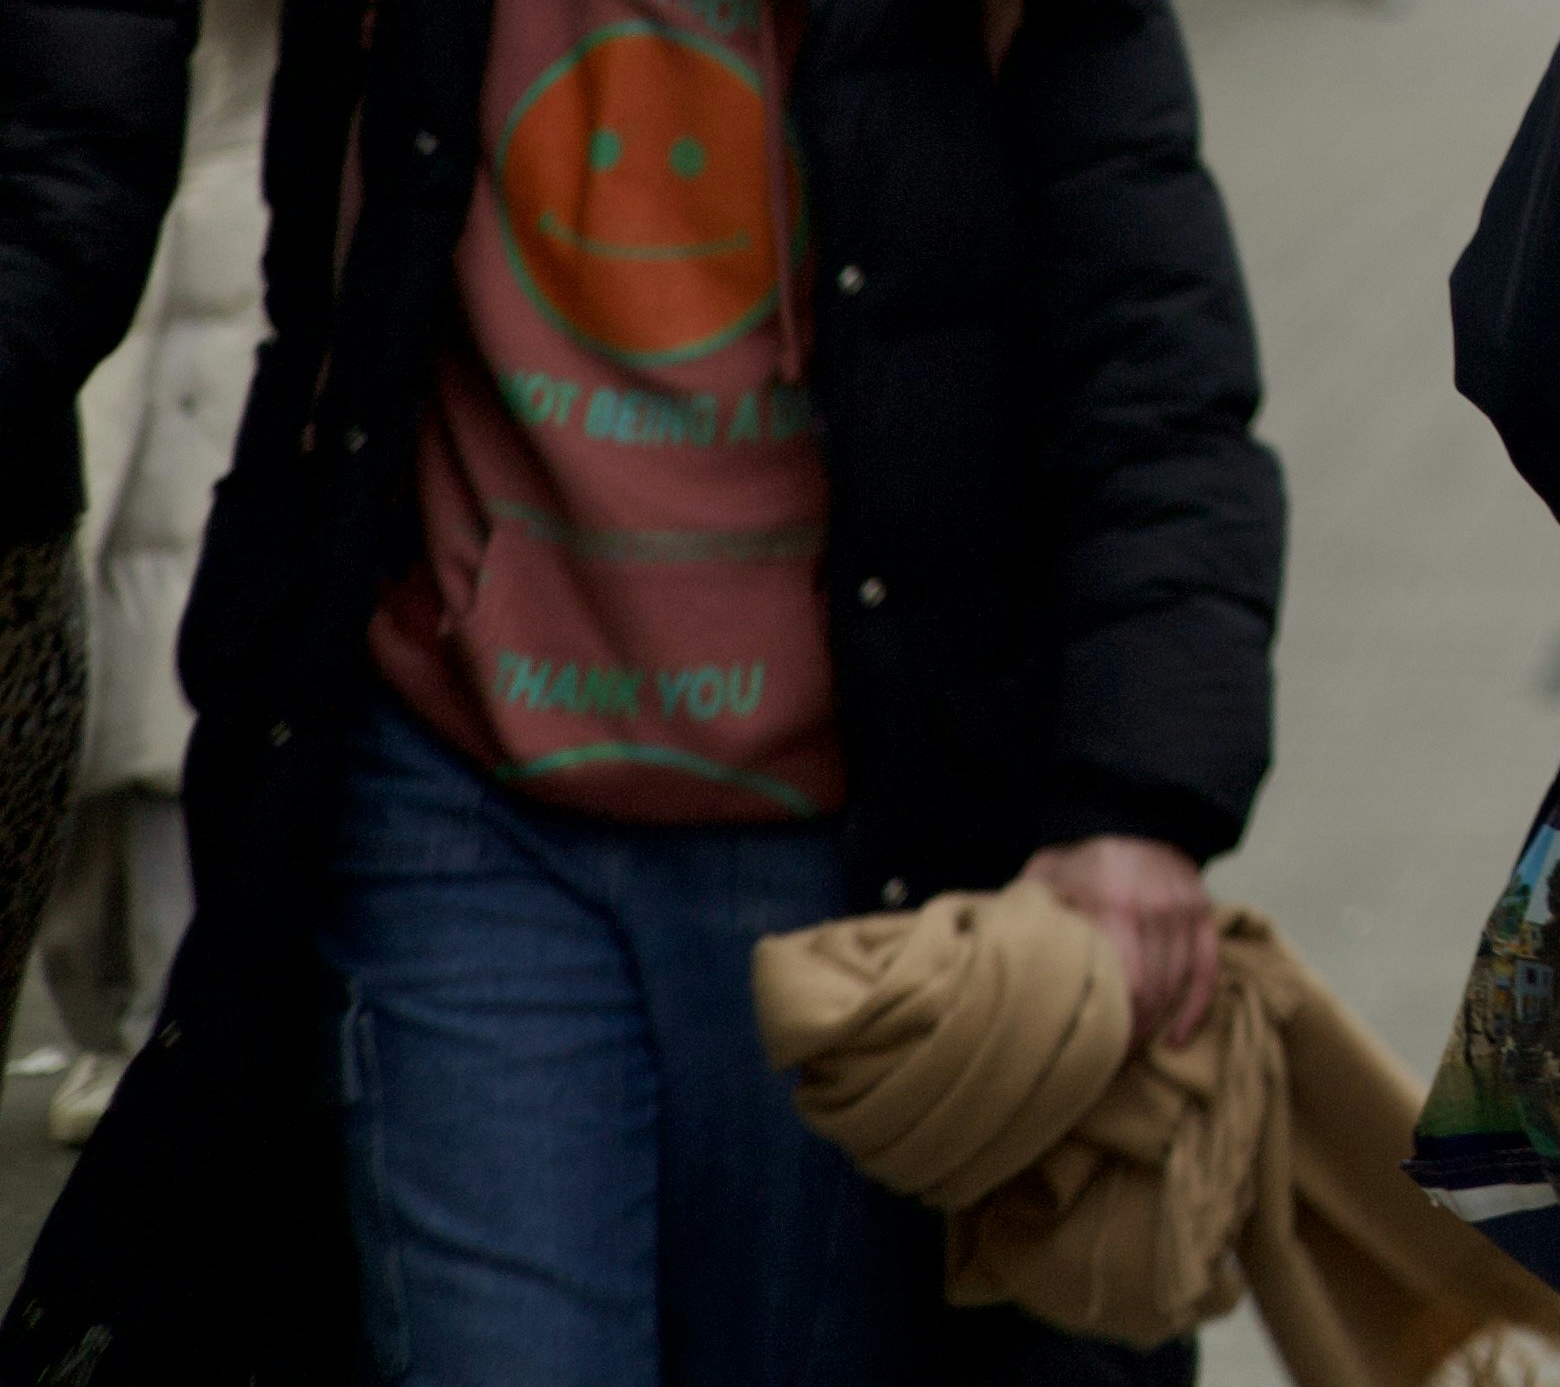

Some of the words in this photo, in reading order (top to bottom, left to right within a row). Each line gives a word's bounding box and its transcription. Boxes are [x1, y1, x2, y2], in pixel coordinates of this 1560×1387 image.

[585, 385, 717, 446] BEING
[727, 387, 759, 442] A
[494, 651, 645, 721] THANK
[657, 658, 768, 723] YOU
